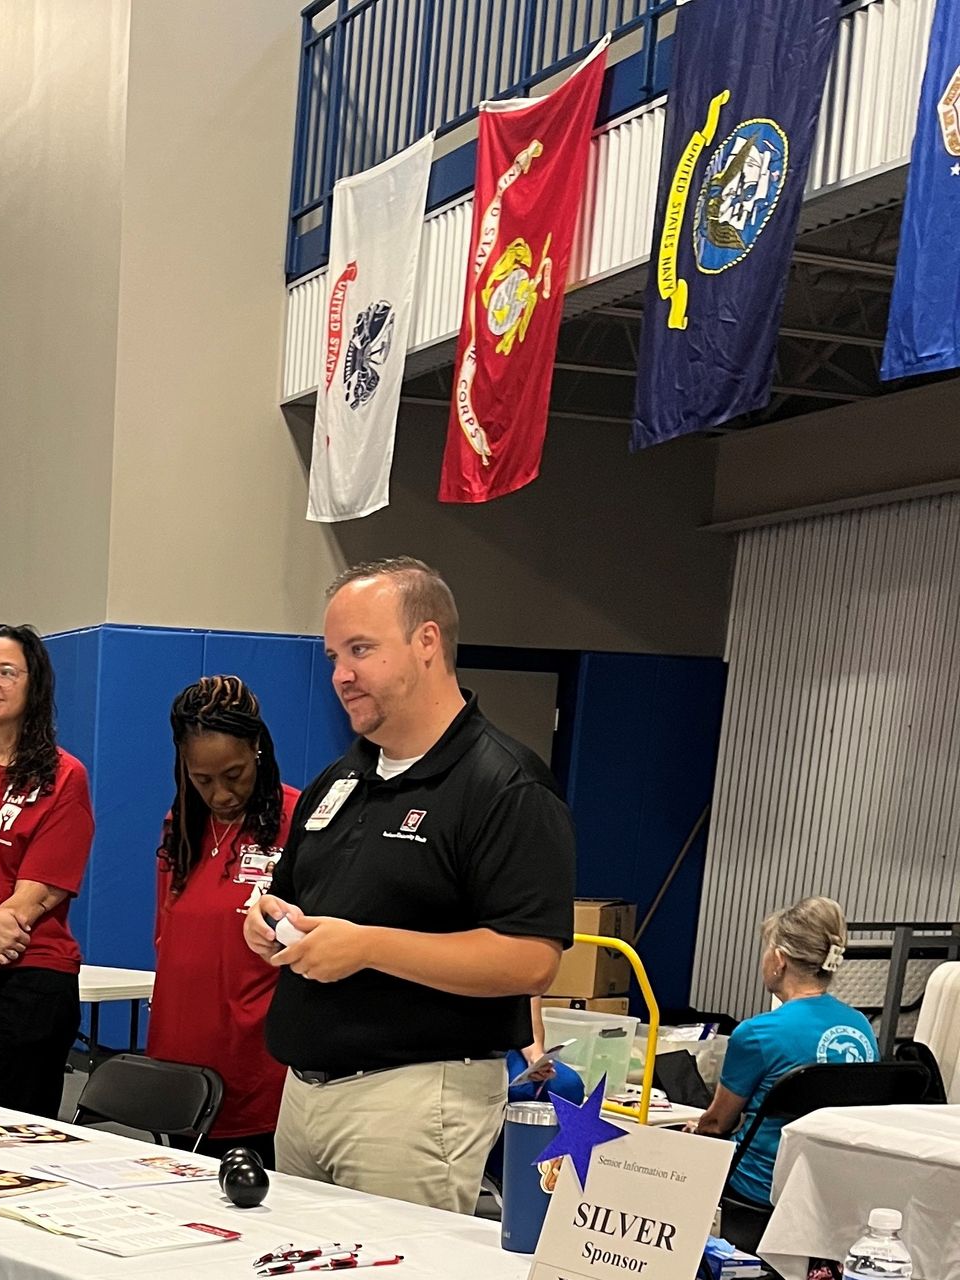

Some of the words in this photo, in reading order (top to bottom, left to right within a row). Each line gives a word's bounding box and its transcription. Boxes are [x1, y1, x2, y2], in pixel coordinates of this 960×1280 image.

[676, 143, 700, 193] UNITED
[664, 202, 682, 249] STATES
[661, 257, 674, 291] NAVY
[330, 281, 347, 332] UNITED
[459, 379, 480, 439] CORPS
[597, 1155, 623, 1170] Senior
[623, 1160, 669, 1180] Information
[670, 1170, 687, 1184] Fair
[573, 1202, 677, 1252] SILVER
[581, 1241, 648, 1274] Sponsor
